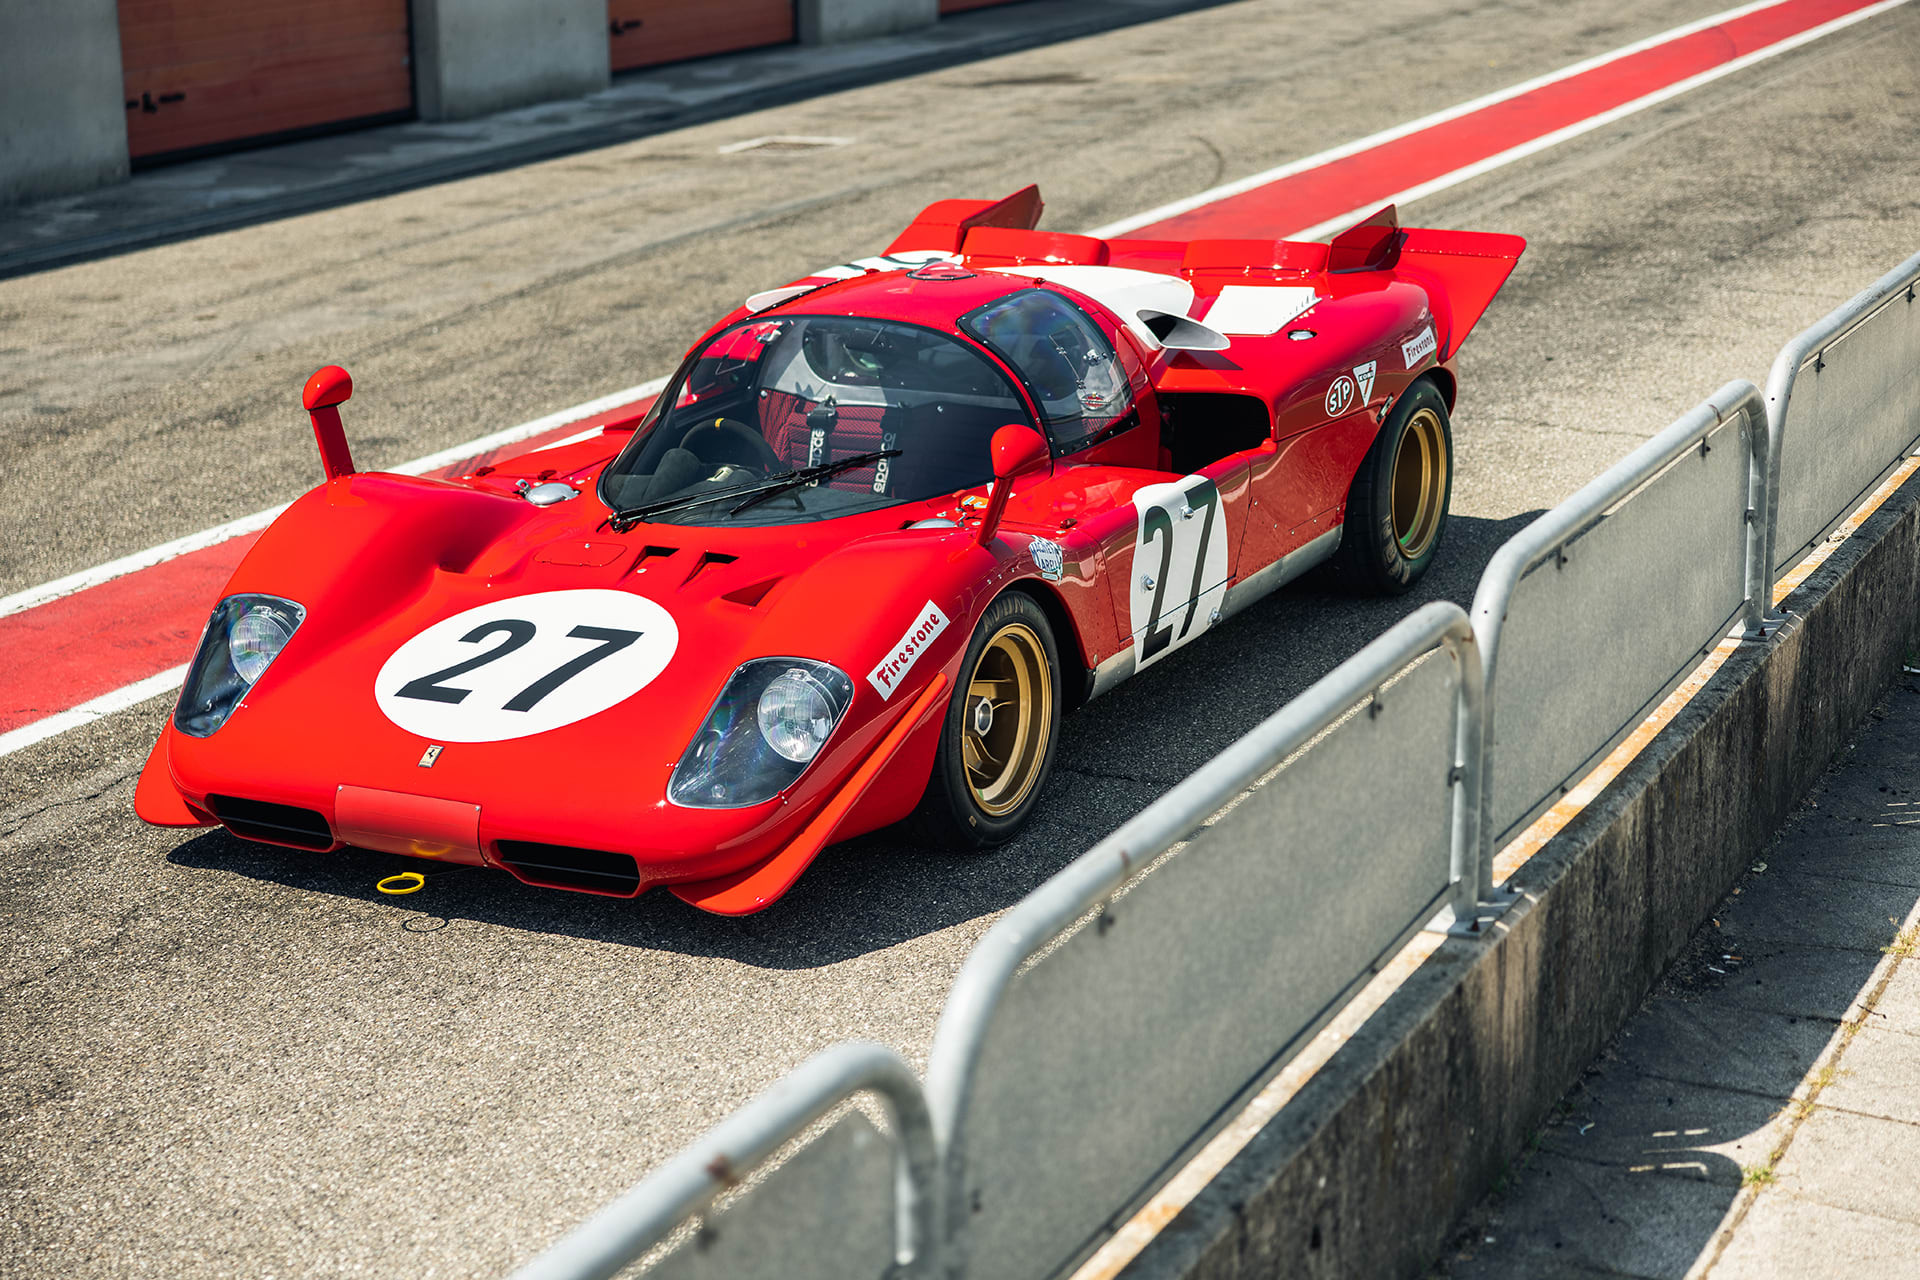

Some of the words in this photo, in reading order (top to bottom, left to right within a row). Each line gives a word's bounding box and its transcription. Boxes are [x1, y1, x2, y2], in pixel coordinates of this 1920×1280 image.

[1329, 379, 1351, 413] STP
[806, 428, 825, 488] sparo
[1140, 478, 1217, 663] 27
[393, 619, 645, 712] 27
[876, 613, 940, 689] Firestone
